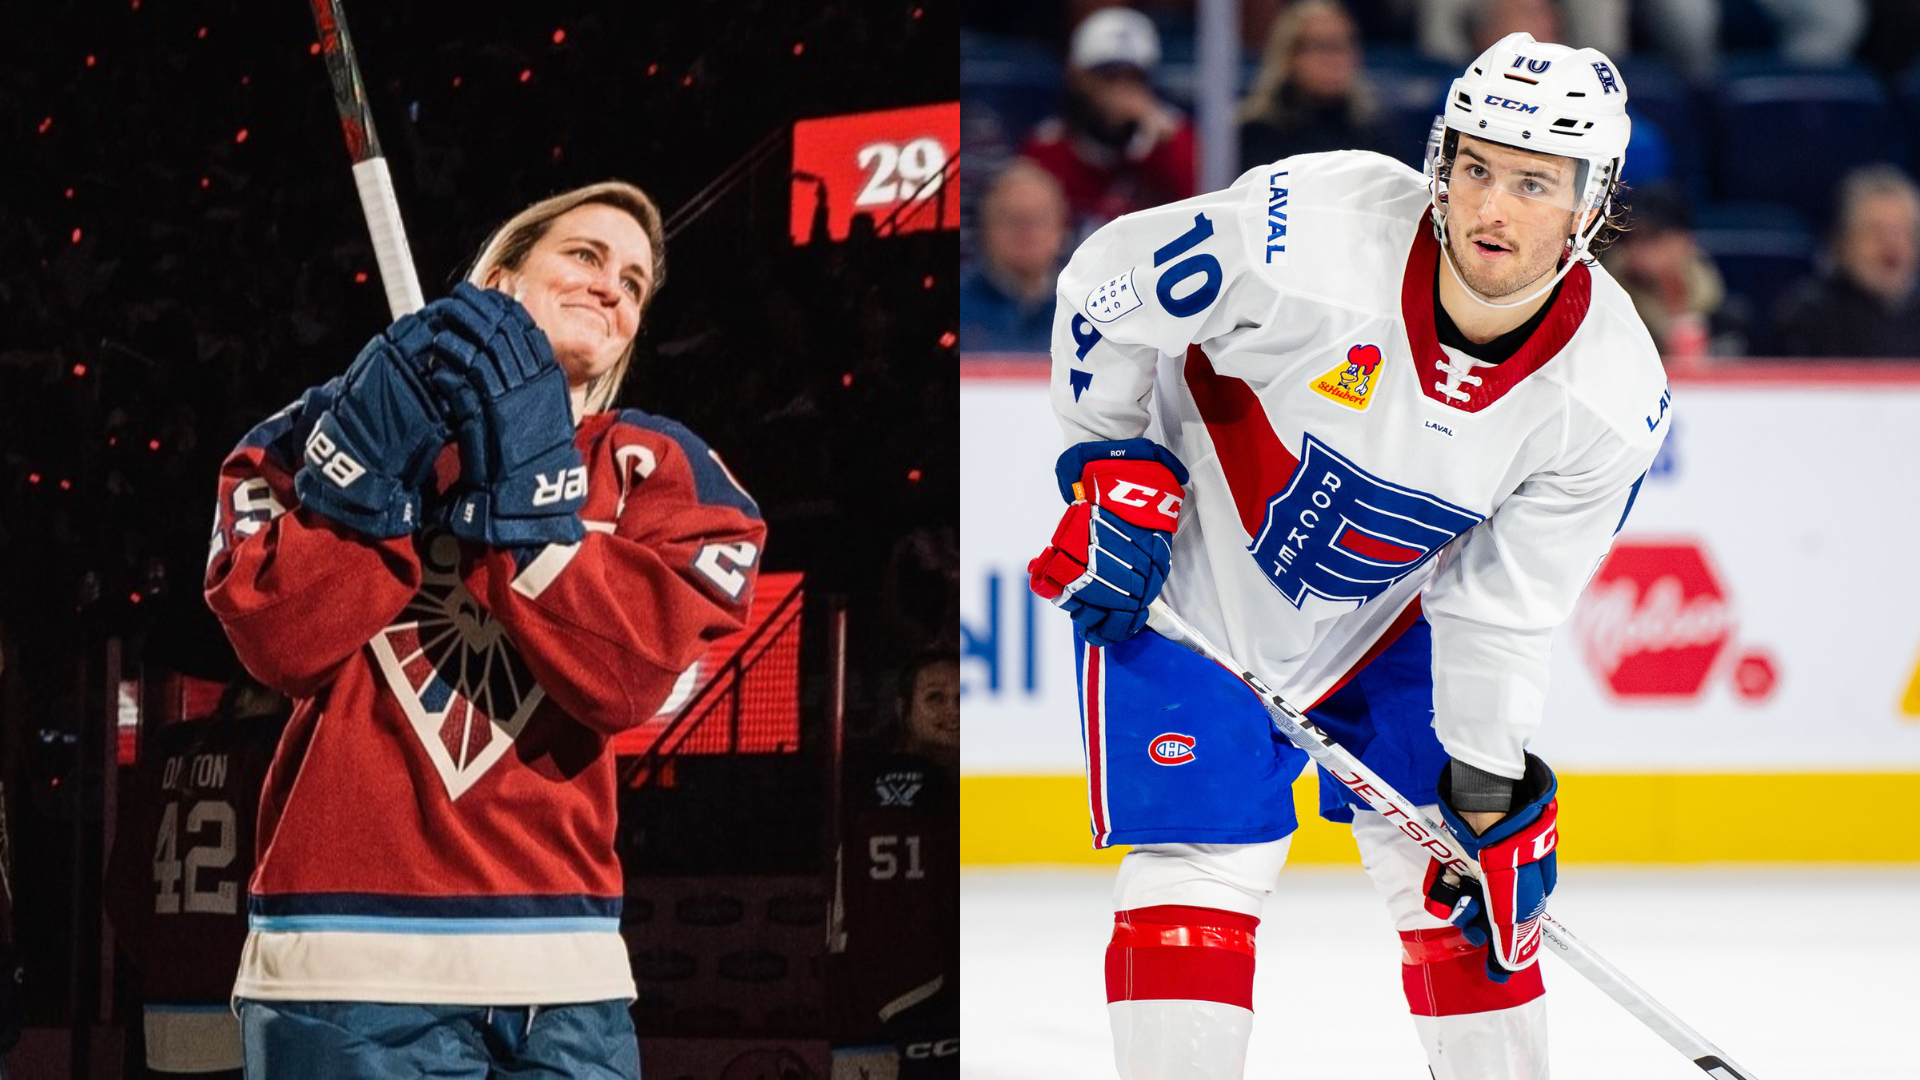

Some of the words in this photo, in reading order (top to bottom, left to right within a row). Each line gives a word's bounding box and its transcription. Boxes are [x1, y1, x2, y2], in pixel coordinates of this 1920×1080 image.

[1484, 94, 1540, 115] CCM
[855, 136, 946, 207] 29
[1266, 171, 1288, 264] LAVAL
[1120, 274, 1128, 293] LE
[1154, 212, 1223, 318] 10
[1110, 449, 1126, 457] ROY
[1425, 420, 1454, 437] LAVAL
[1272, 471, 1342, 578] ROCKET
[1242, 671, 1336, 748] CCM
[153, 800, 238, 915] 42
[868, 836, 925, 880] 51
[1548, 934, 1569, 951] PRO
